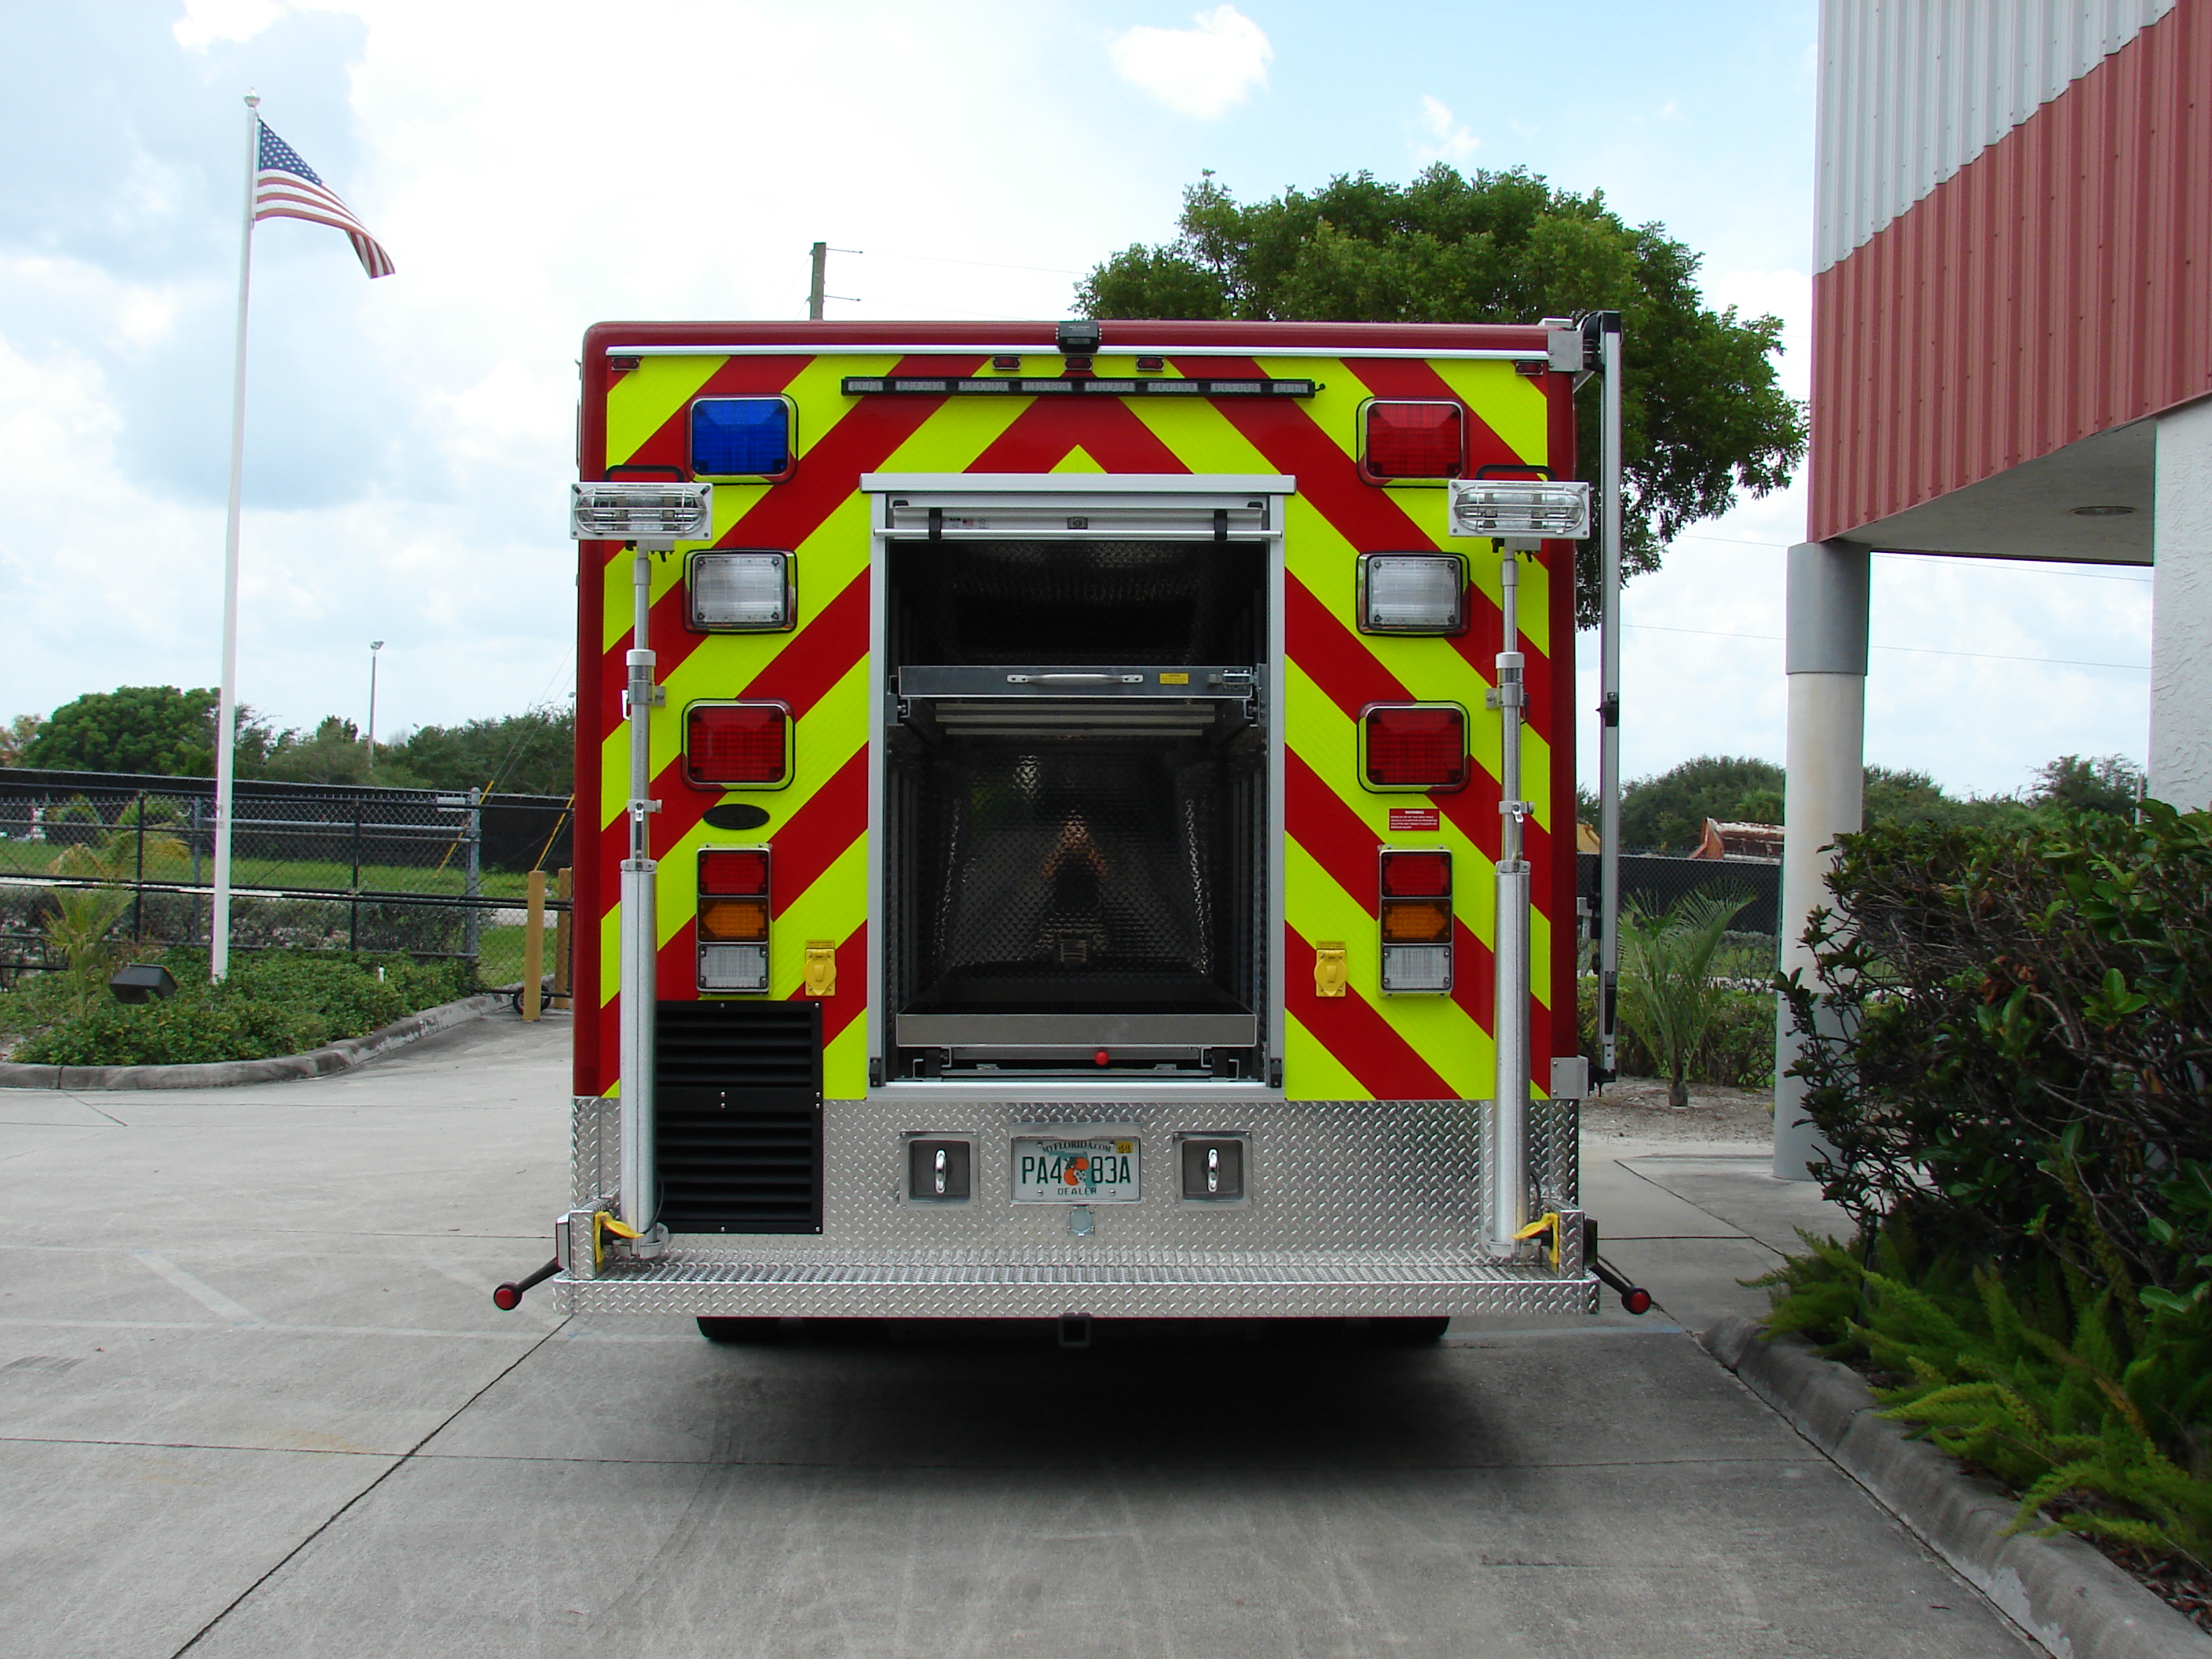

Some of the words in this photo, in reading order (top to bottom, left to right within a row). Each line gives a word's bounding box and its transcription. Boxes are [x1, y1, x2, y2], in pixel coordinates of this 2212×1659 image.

[1042, 1141, 1111, 1153] MYFLORIDA.COM
[1022, 1156, 1062, 1184] PA4
[1091, 1156, 1131, 1184] 83A
[1057, 1187, 1097, 1196] DEALER
